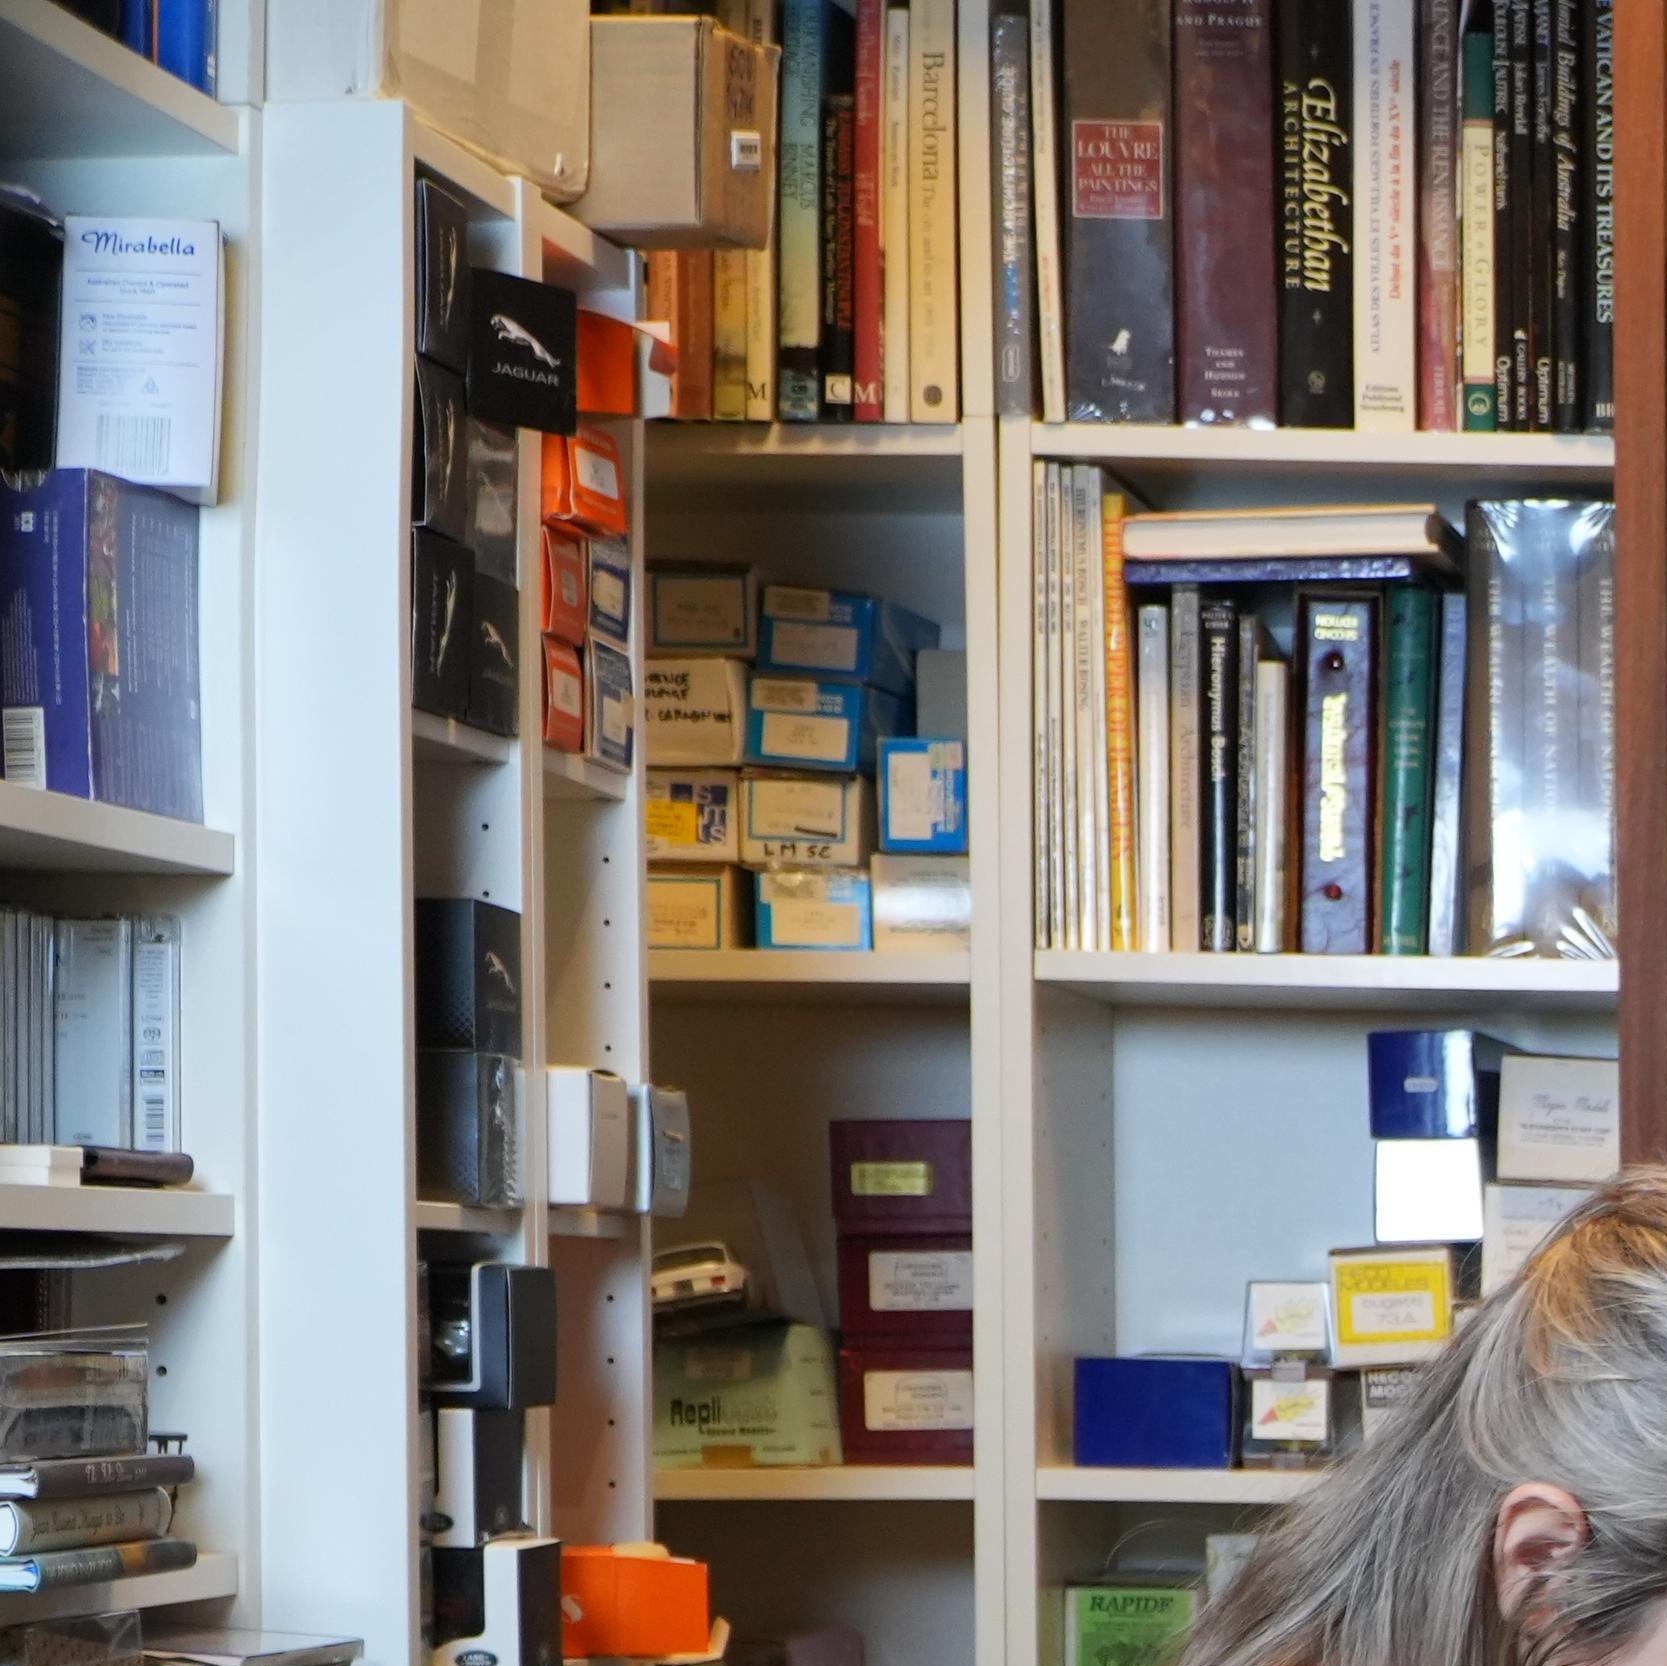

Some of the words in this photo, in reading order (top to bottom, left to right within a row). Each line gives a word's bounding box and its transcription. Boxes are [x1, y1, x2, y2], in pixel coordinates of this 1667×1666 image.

[1207, 14, 1263, 28] PRAGUE
[1595, 13, 1612, 101] VATICAN
[1432, 62, 1449, 100] AND
[1556, 51, 1576, 127] Buildings
[921, 53, 946, 181] Barcelona
[1104, 126, 1130, 139] THE
[1432, 106, 1449, 139] THE
[1595, 111, 1612, 159] AND
[1078, 141, 1158, 160] LOUVRE
[1556, 133, 1576, 151] of
[1078, 178, 1159, 192] PAINTINGS
[1091, 163, 1115, 177] ALL
[1118, 163, 1148, 177] THE
[1283, 80, 1300, 289] ARCHITECTURE
[1301, 78, 1348, 292] Elizabethan
[1473, 144, 1490, 234] POWER
[1556, 154, 1576, 232] Australia
[1595, 162, 1612, 198] ITS
[1431, 146, 1451, 271] RENAISSANCE
[81, 231, 196, 256] Mirabella
[1595, 202, 1613, 323] TREASURES
[1474, 257, 1490, 348] GLORY
[490, 361, 561, 387] JAGUAR
[1496, 356, 1510, 422] Optimum
[1537, 357, 1551, 423] Optimum
[1074, 487, 1088, 566] HIERONYMUS
[1075, 569, 1088, 605] BOSCH
[1543, 577, 1557, 616] THE
[1208, 636, 1225, 732] Hieronymus
[1543, 623, 1557, 706] WEALTH
[1544, 712, 1557, 739] OF
[1179, 725, 1196, 829] Architecture
[1210, 736, 1225, 782] Bosch
[1362, 1296, 1423, 1309] bugatti
[1089, 1596, 1174, 1612] RAPIDE
